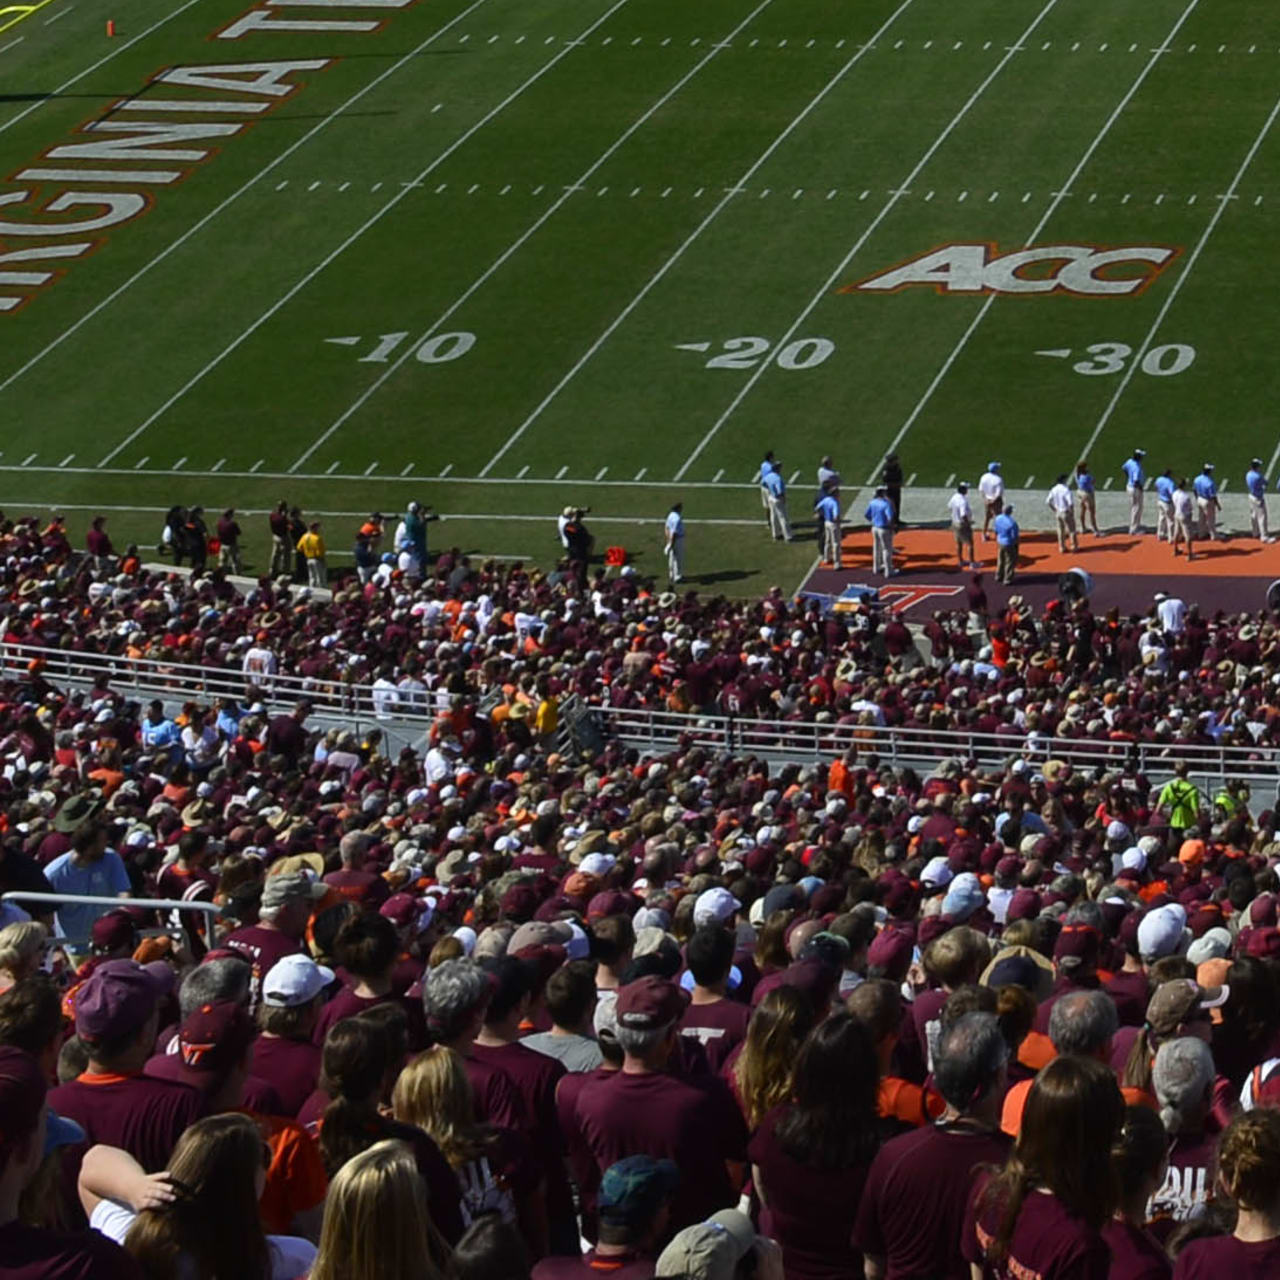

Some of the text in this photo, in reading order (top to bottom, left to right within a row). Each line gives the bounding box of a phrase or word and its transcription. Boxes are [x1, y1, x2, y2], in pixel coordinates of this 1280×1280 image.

[850, 244, 1178, 295] ACC
[357, 330, 477, 364] 10
[705, 336, 835, 370] 20
[1073, 342, 1197, 376] 30
